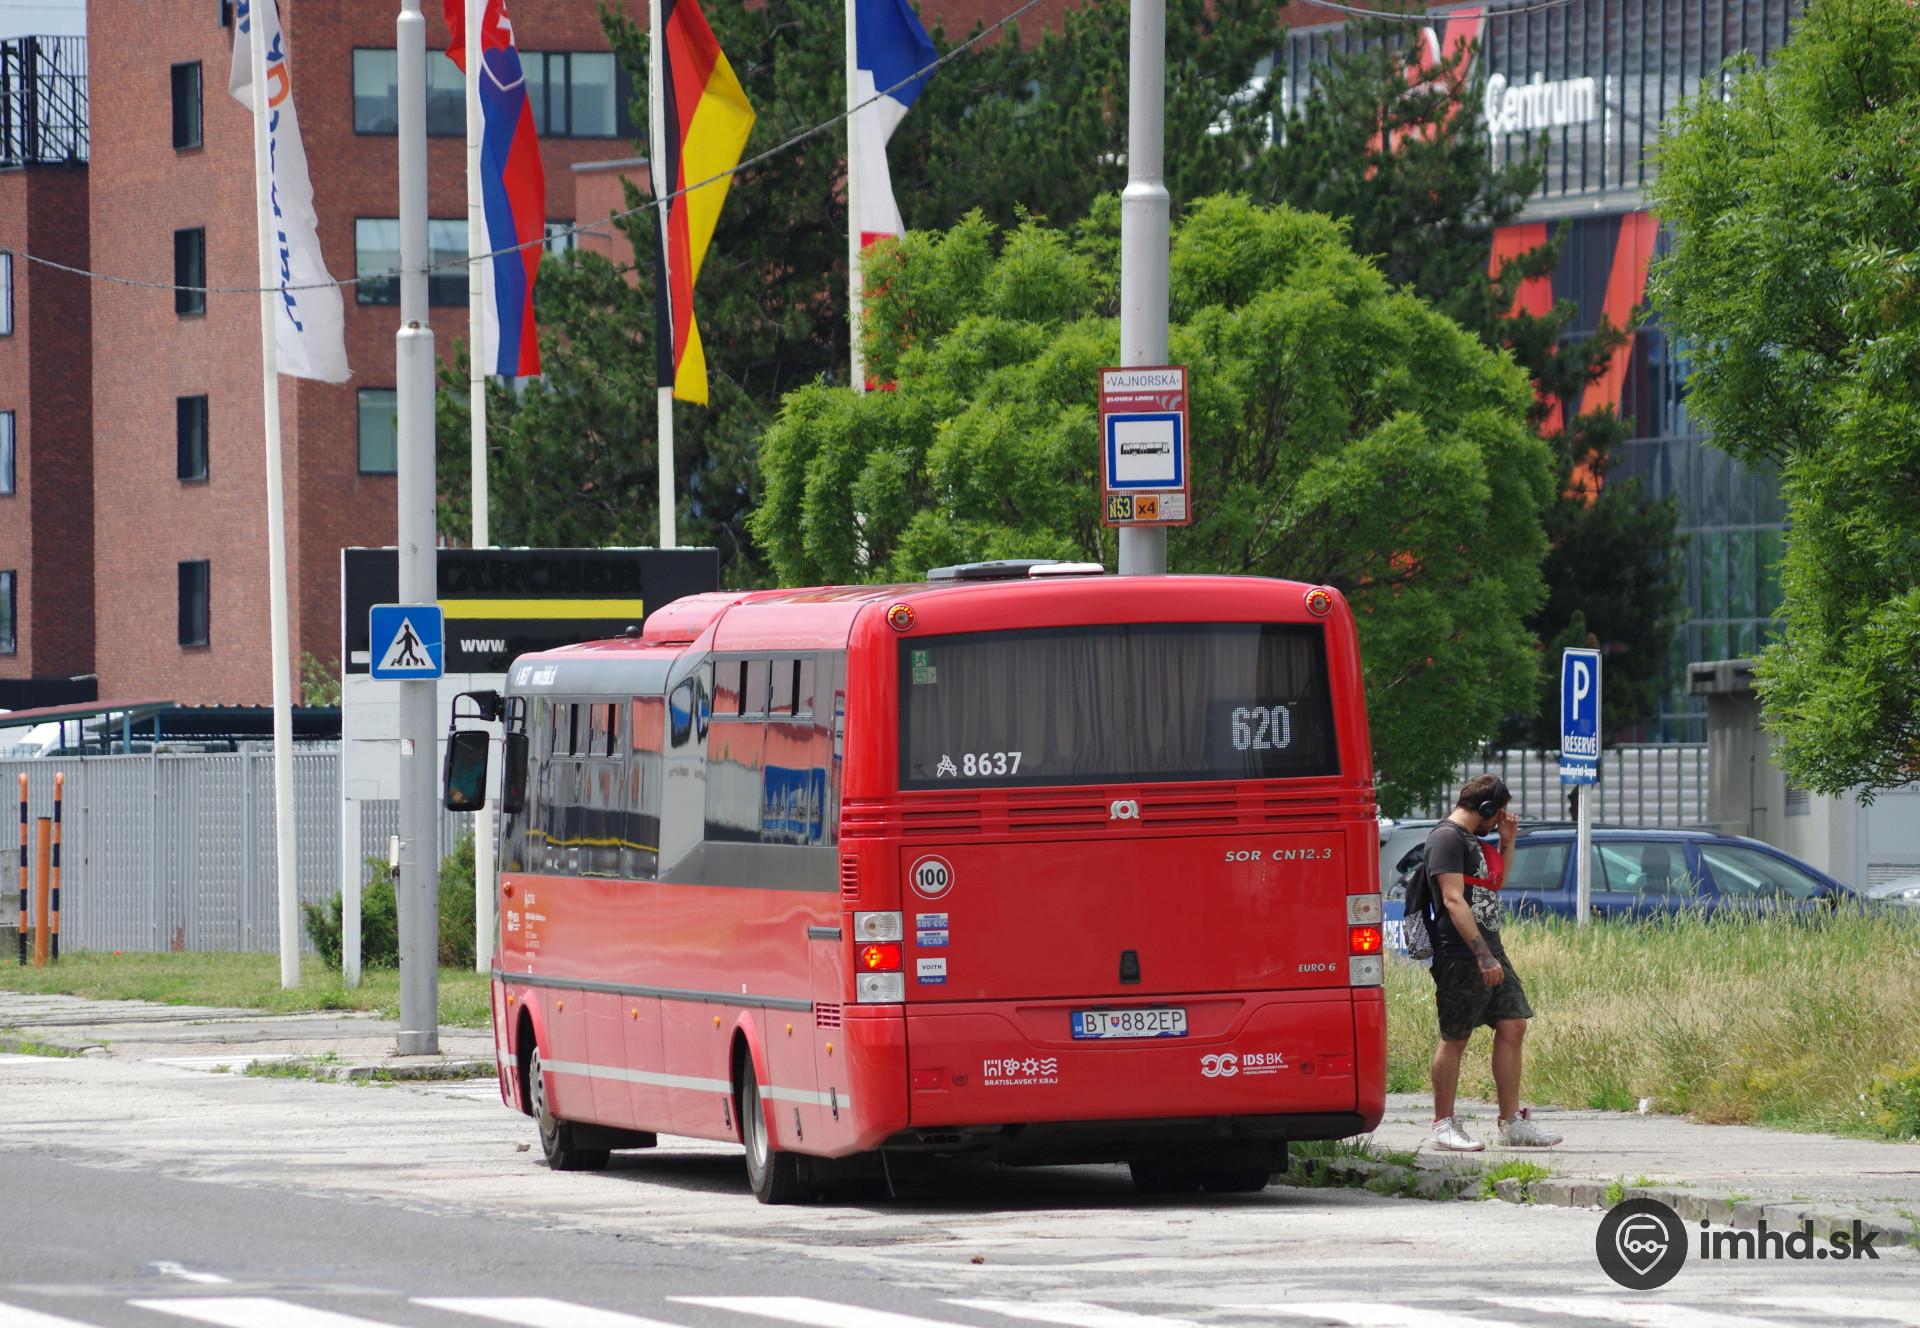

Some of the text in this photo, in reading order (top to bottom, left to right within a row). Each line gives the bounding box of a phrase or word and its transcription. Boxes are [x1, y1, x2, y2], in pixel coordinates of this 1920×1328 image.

[1484, 71, 1595, 134] Centrum
[1110, 373, 1177, 387] VAJNORSKÁ
[1138, 501, 1156, 514] x4
[1572, 660, 1590, 721] P
[1232, 705, 1291, 750] 620
[1564, 731, 1596, 754] RÉSERVÉ
[963, 752, 1022, 776] 8637
[1225, 850, 1261, 862] SOR
[918, 868, 946, 886] 100
[1298, 963, 1336, 972] EURO 6
[1085, 1012, 1182, 1032] BT 882EP
[1243, 1052, 1283, 1066] IDS BK
[984, 1078, 1037, 1086] BRATISLAVSKÝ
